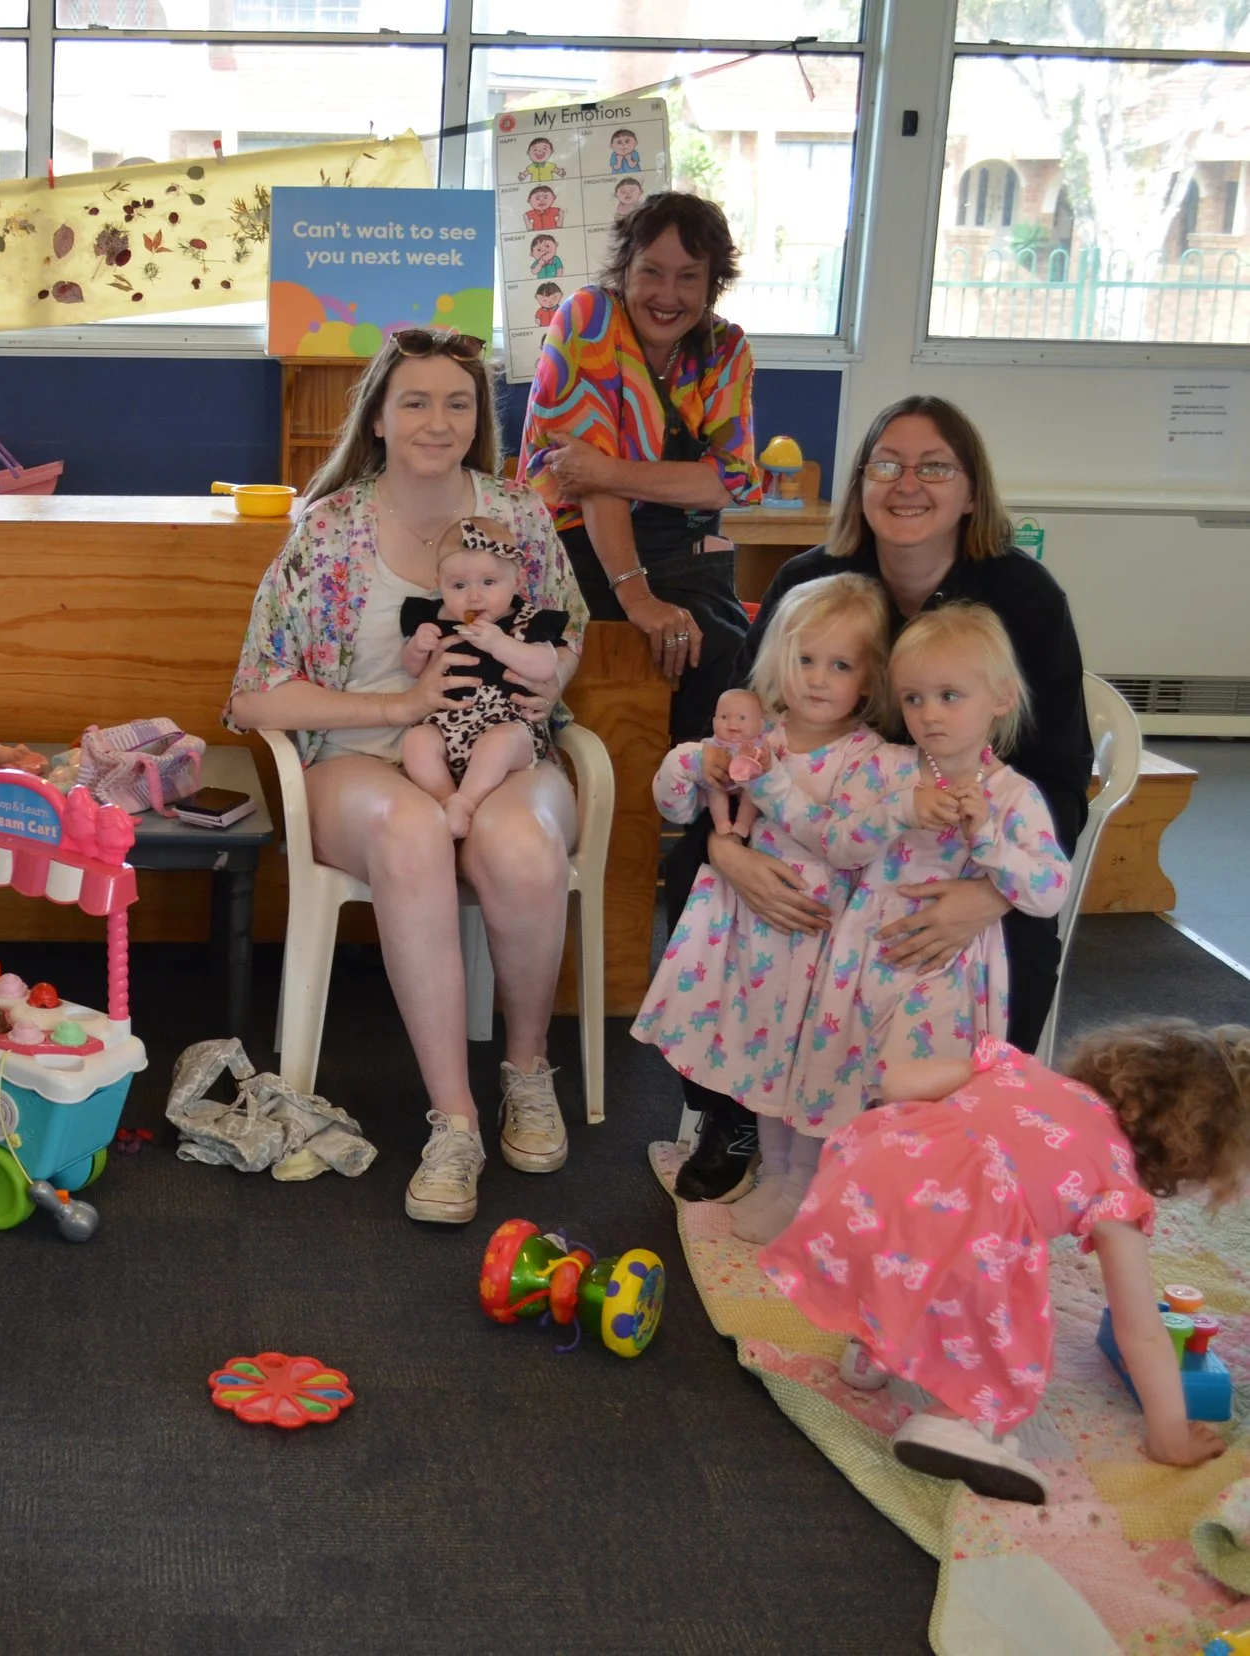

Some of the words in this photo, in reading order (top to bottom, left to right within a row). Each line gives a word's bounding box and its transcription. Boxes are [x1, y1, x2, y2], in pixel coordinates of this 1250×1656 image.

[534, 110, 556, 129] My
[561, 104, 631, 124] Emotions
[292, 220, 351, 240] Can't
[356, 221, 405, 241] wait
[410, 222, 433, 241] to
[439, 225, 477, 242] see
[305, 249, 346, 269] you
[351, 247, 400, 266] next
[405, 247, 464, 267] week
[21, 803, 49, 818] Learn
[28, 820, 58, 838] Cart
[1012, 1105, 1070, 1149] Barbie
